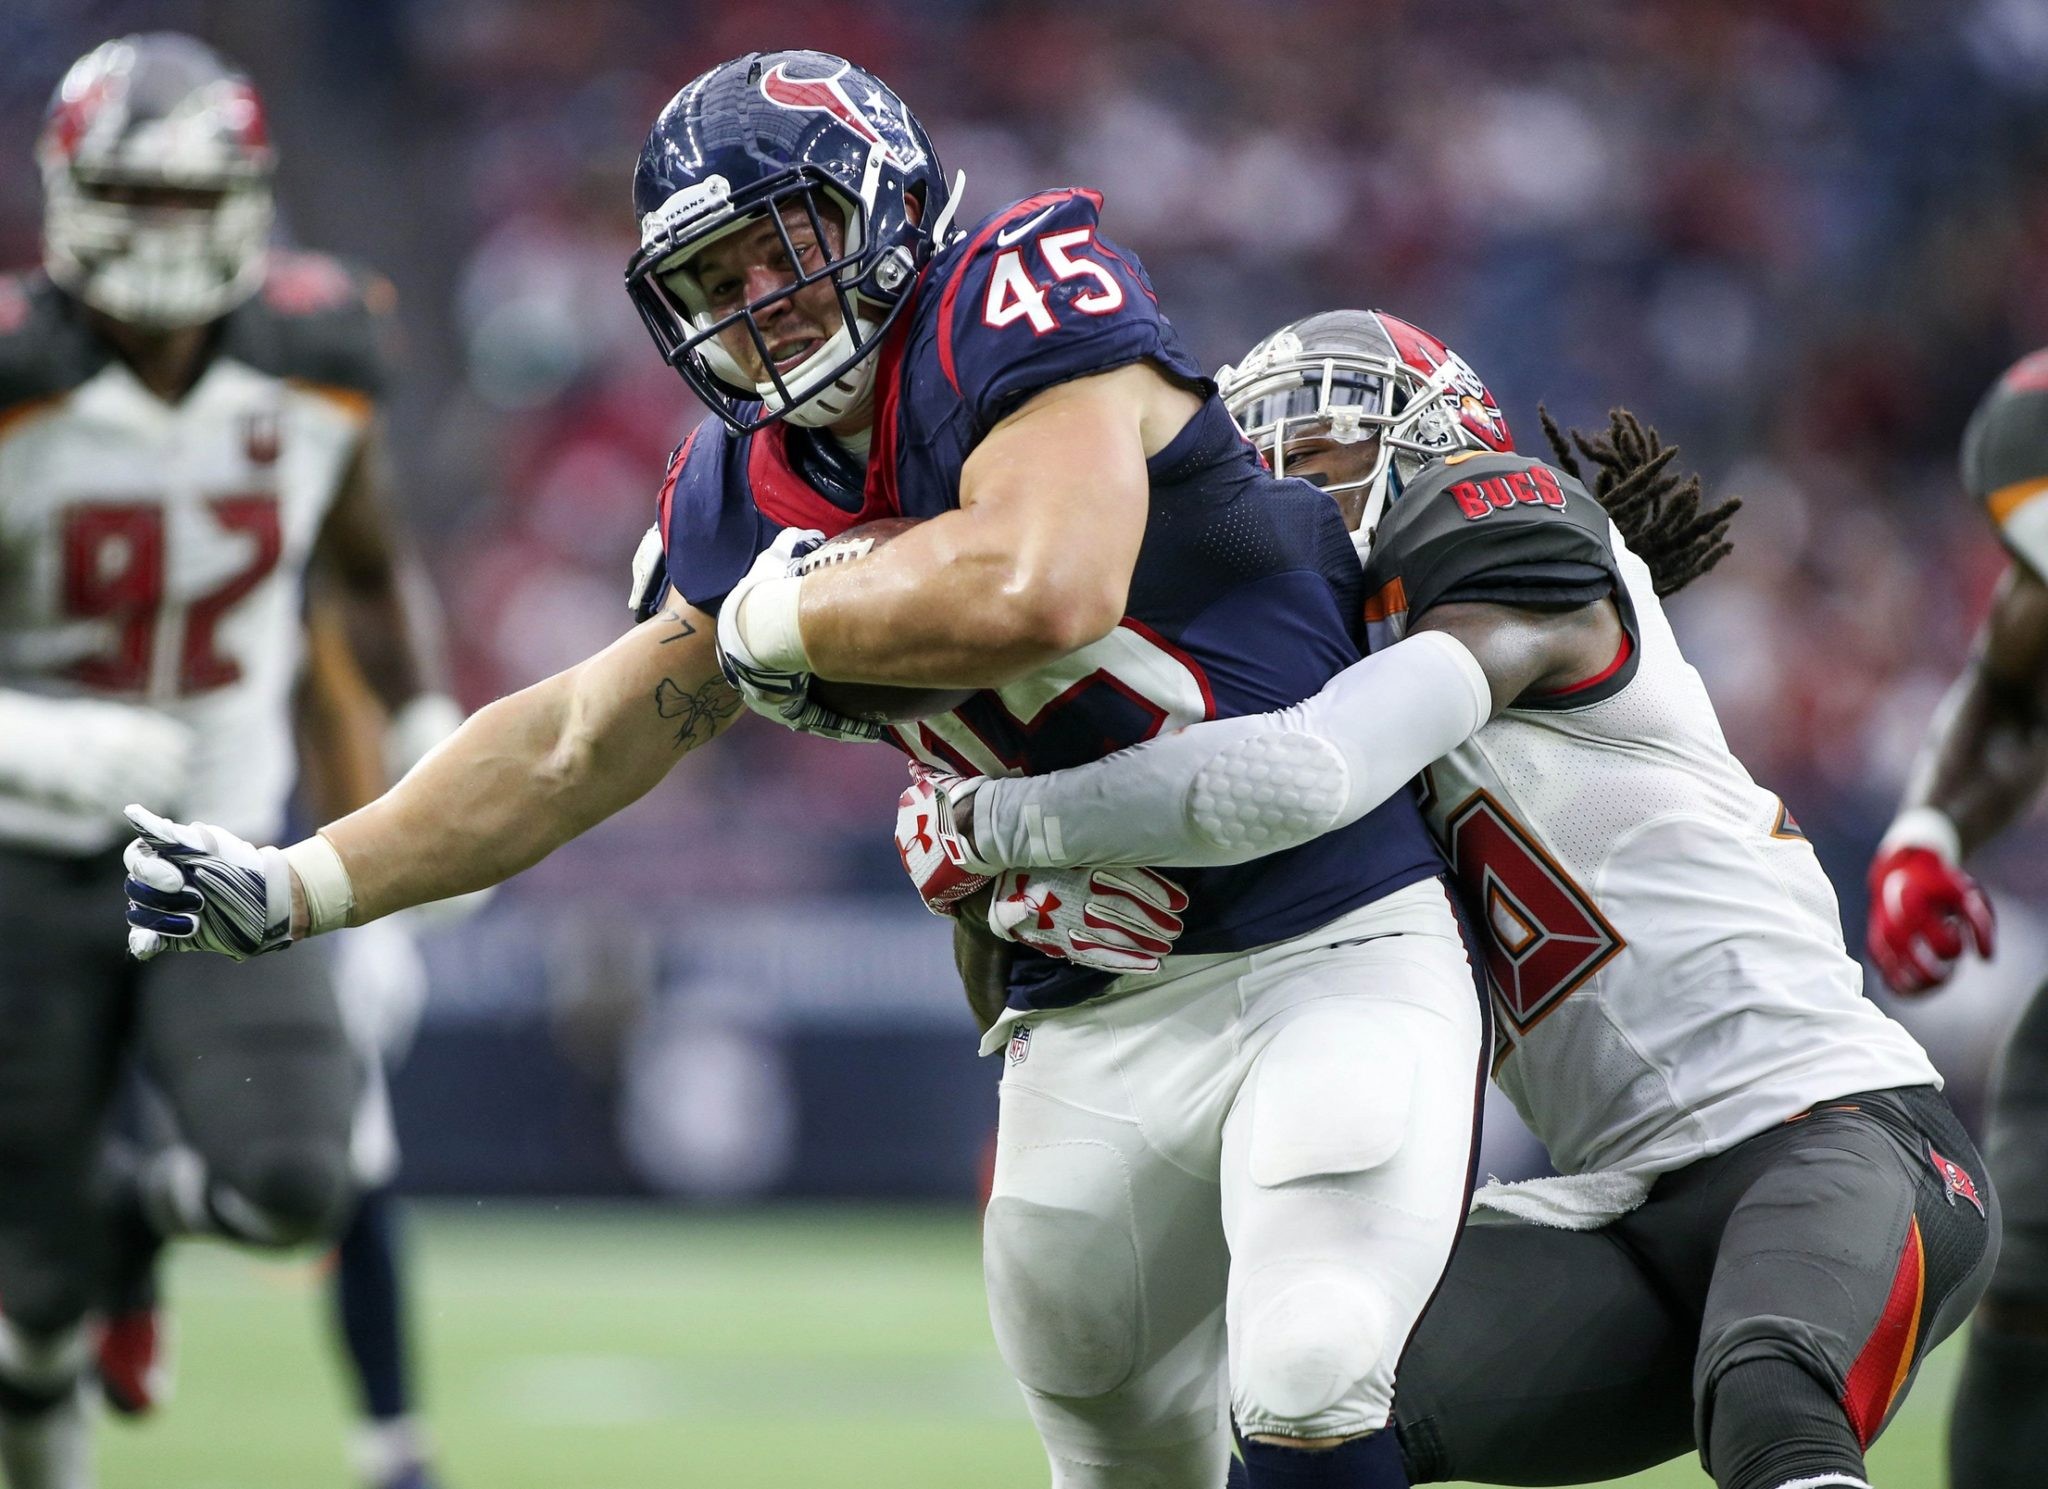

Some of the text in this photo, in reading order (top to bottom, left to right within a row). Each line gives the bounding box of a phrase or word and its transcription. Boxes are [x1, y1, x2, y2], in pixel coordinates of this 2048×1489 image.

[665, 197, 705, 222] TEXANS
[981, 223, 1125, 337] 45
[1446, 465, 1567, 521] BUCS
[61, 496, 284, 697] 92
